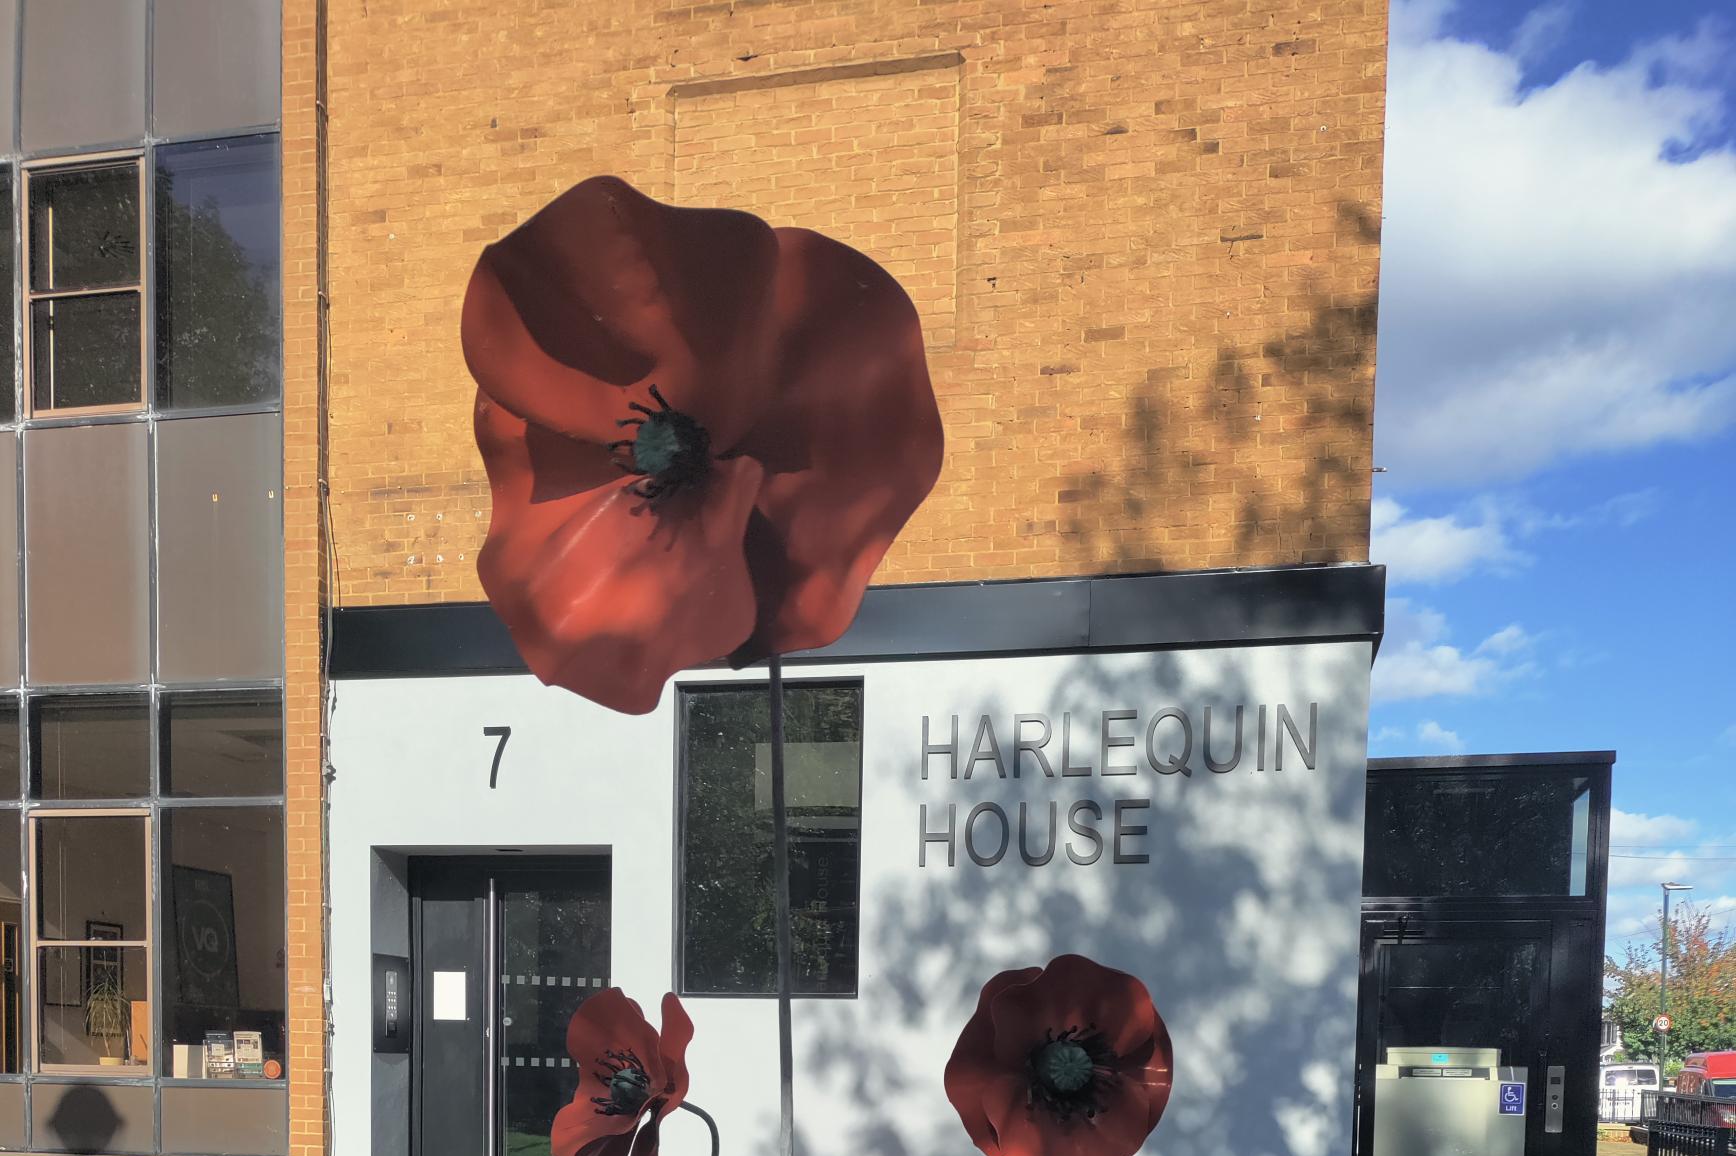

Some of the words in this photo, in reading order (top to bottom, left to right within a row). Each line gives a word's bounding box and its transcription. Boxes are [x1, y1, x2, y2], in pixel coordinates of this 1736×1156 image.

[482, 726, 512, 790] 7
[920, 702, 1318, 780] HARLEQUIN
[918, 798, 1151, 868] HOUSE
[1658, 1019, 1669, 1027] 20
